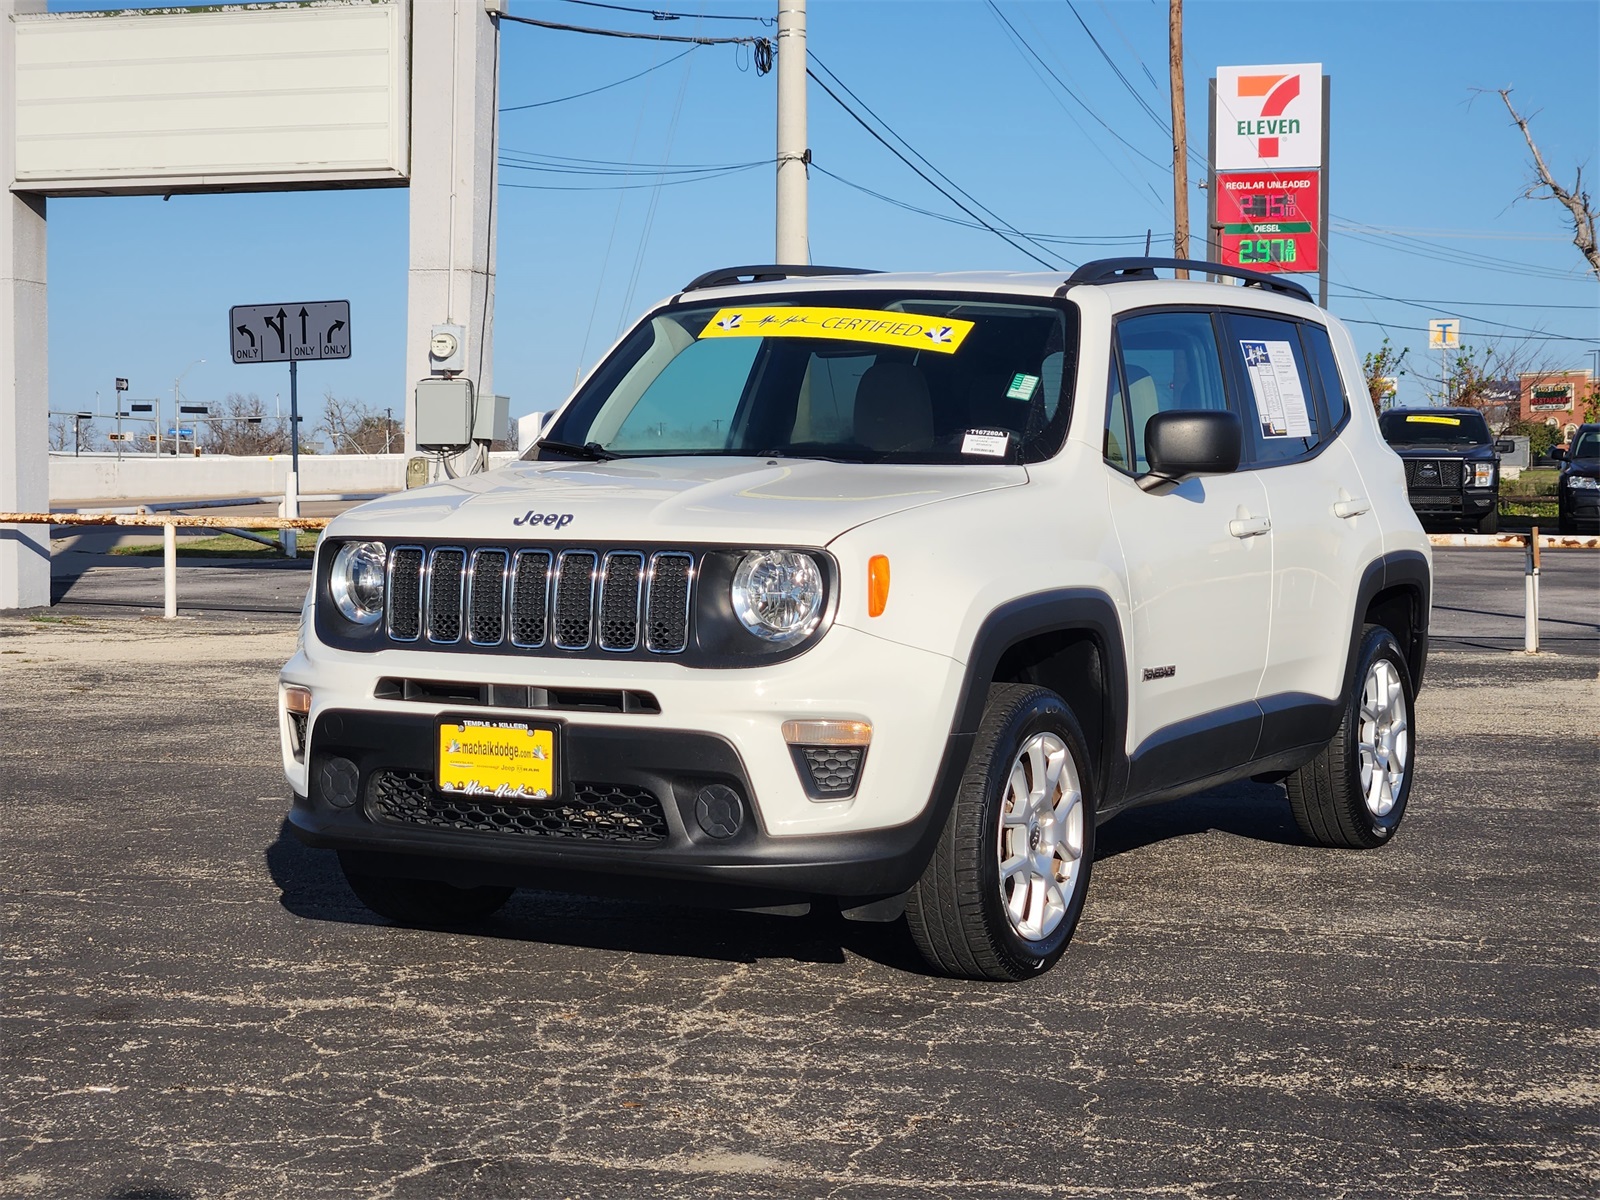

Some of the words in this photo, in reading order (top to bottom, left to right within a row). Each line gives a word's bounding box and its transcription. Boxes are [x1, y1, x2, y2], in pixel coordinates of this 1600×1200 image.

[1226, 182, 1264, 190] REGULAR
[1267, 180, 1310, 188] UNLEADED
[1253, 224, 1281, 233] DIESEL
[1239, 239, 1284, 263] 2.97
[821, 316, 923, 337] CERTIFIED
[236, 348, 259, 359] ONLY
[294, 346, 315, 356] ONLY
[323, 345, 347, 355] ONLY
[513, 510, 574, 530] Jeep
[463, 720, 490, 728] TEMPLE
[499, 722, 528, 730] KILLEEN
[462, 741, 531, 760] machaikdodge.com
[501, 764, 515, 772] Jeep
[464, 780, 491, 795] Mac
